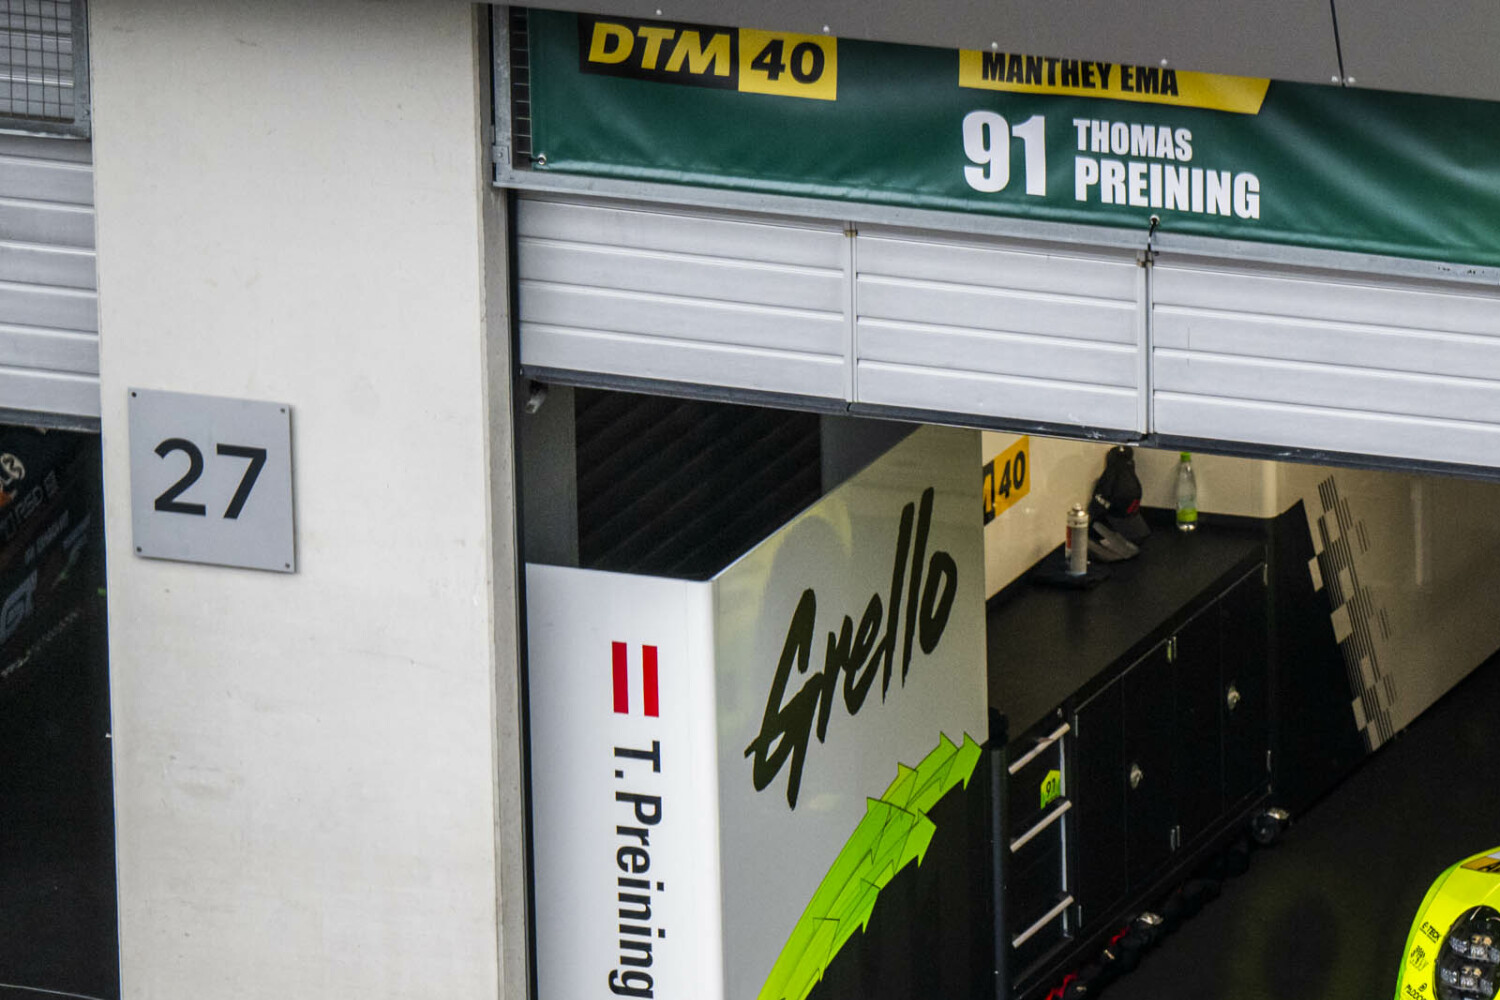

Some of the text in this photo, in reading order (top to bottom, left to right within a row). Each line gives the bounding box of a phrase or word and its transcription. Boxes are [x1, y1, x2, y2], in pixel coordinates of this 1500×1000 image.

[588, 22, 825, 84] DTM 40
[982, 51, 1179, 97] MANTHEY EMA
[962, 110, 1046, 196] 91
[1073, 118, 1192, 162] THOMAS
[1075, 156, 1260, 219] PREINING
[154, 437, 267, 520] 27
[999, 450, 1026, 498] 40
[744, 486, 957, 811] Grello
[608, 740, 666, 999] T. Preining
